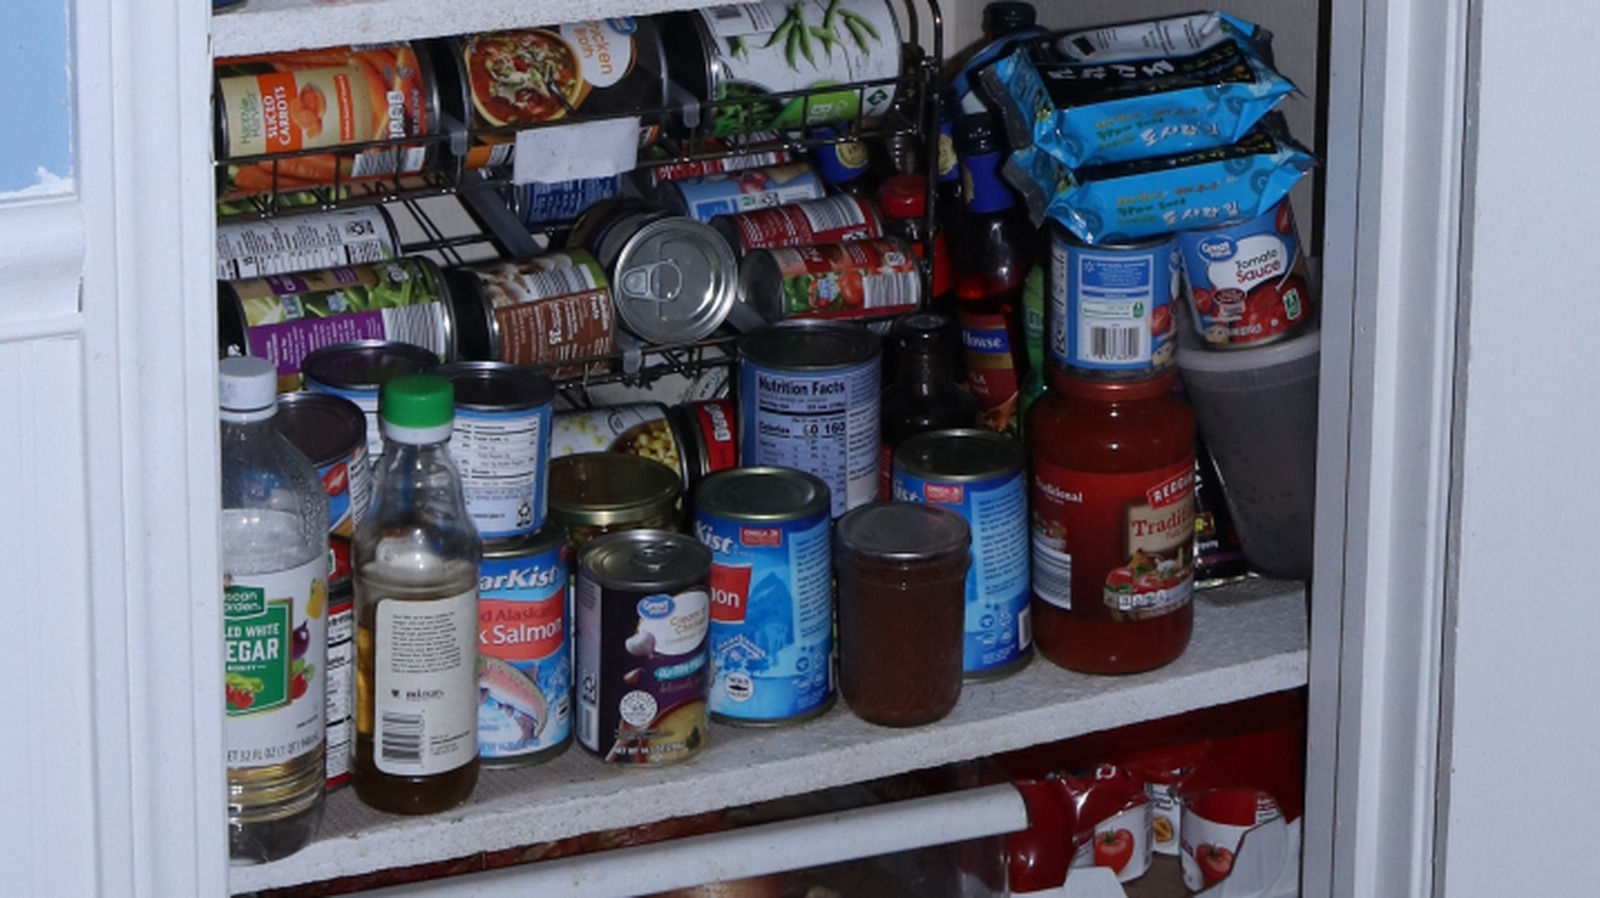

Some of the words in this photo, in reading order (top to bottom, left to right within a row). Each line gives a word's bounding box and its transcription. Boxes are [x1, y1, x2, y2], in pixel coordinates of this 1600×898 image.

[273, 85, 292, 146] CARROTS
[1234, 248, 1279, 272] Tomato
[1235, 259, 1281, 285] Sauce
[759, 376, 808, 396] Nutrition
[812, 380, 846, 396] Facts
[824, 422, 846, 435] 160
[695, 520, 734, 556] Kist
[479, 566, 559, 591] arKist
[245, 622, 280, 637] WHITE
[493, 618, 562, 645] Salmon
[225, 638, 280, 662] EGAR
